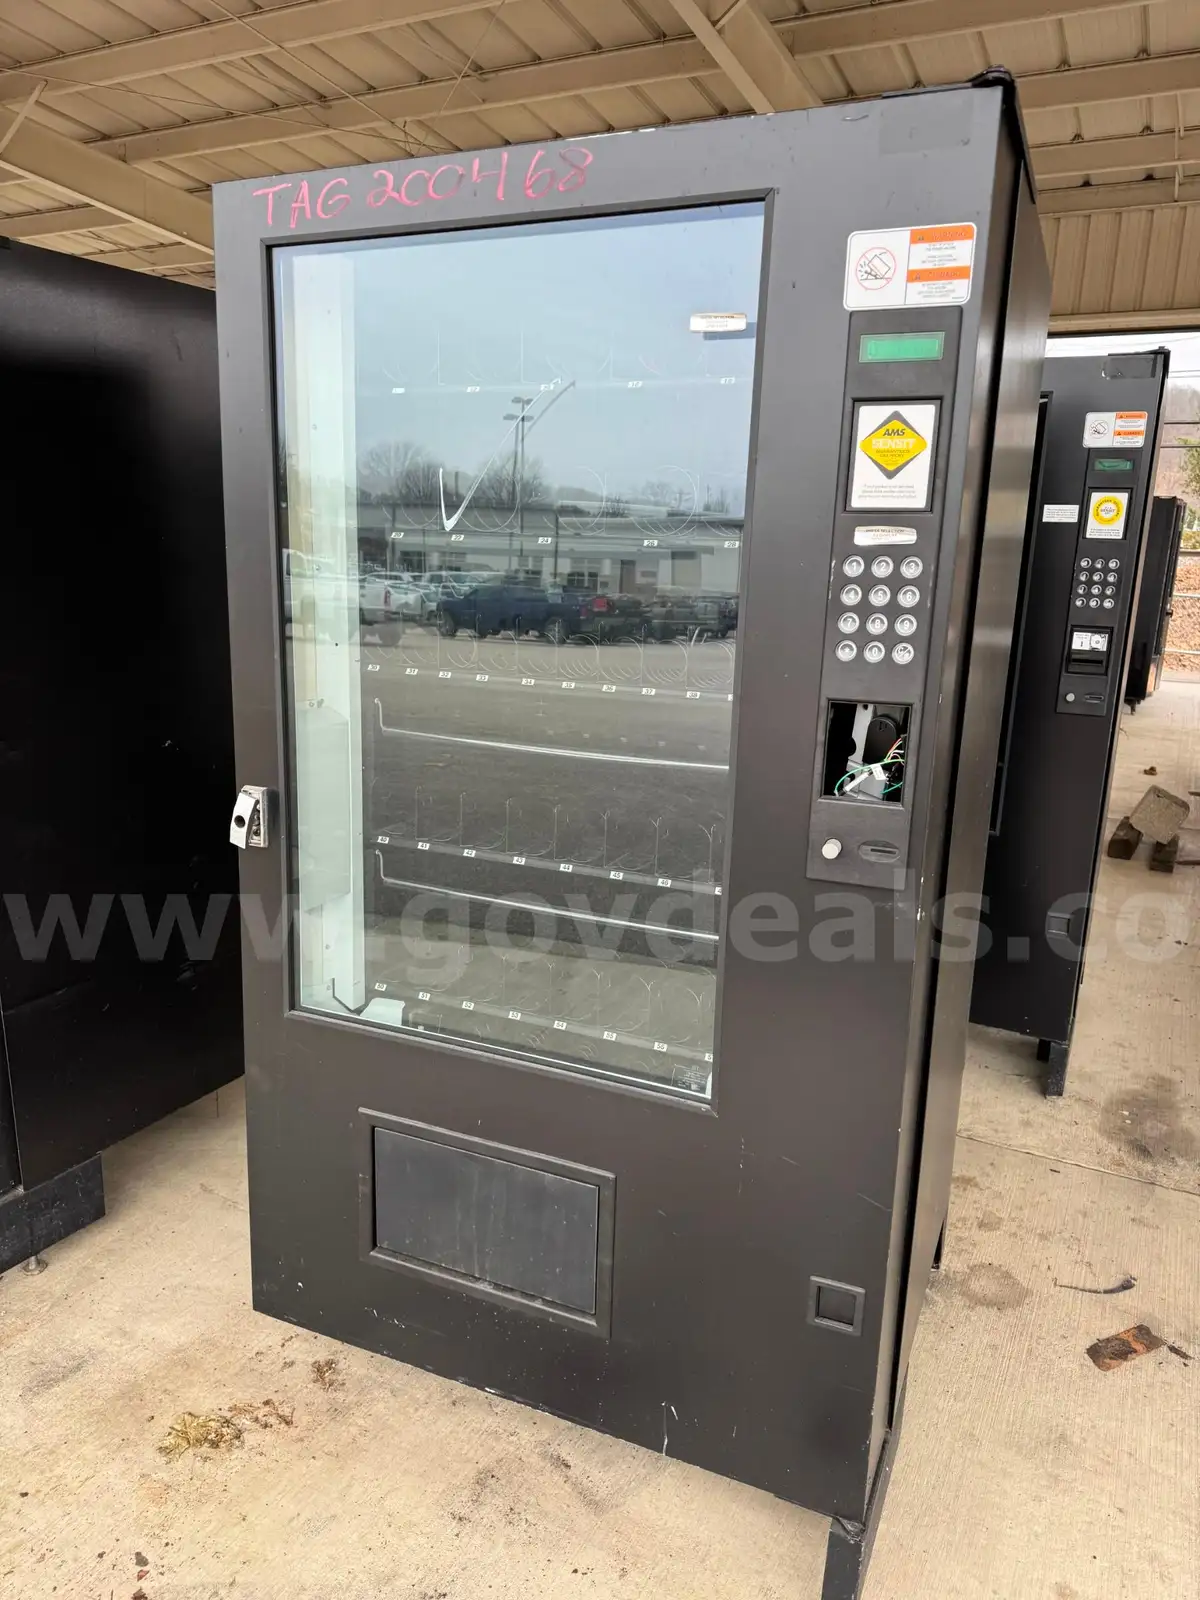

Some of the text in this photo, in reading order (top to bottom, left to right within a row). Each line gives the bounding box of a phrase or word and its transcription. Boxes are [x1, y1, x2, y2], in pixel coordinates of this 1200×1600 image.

[253, 147, 593, 228] TAG 200468
[883, 428, 906, 437] AMS
